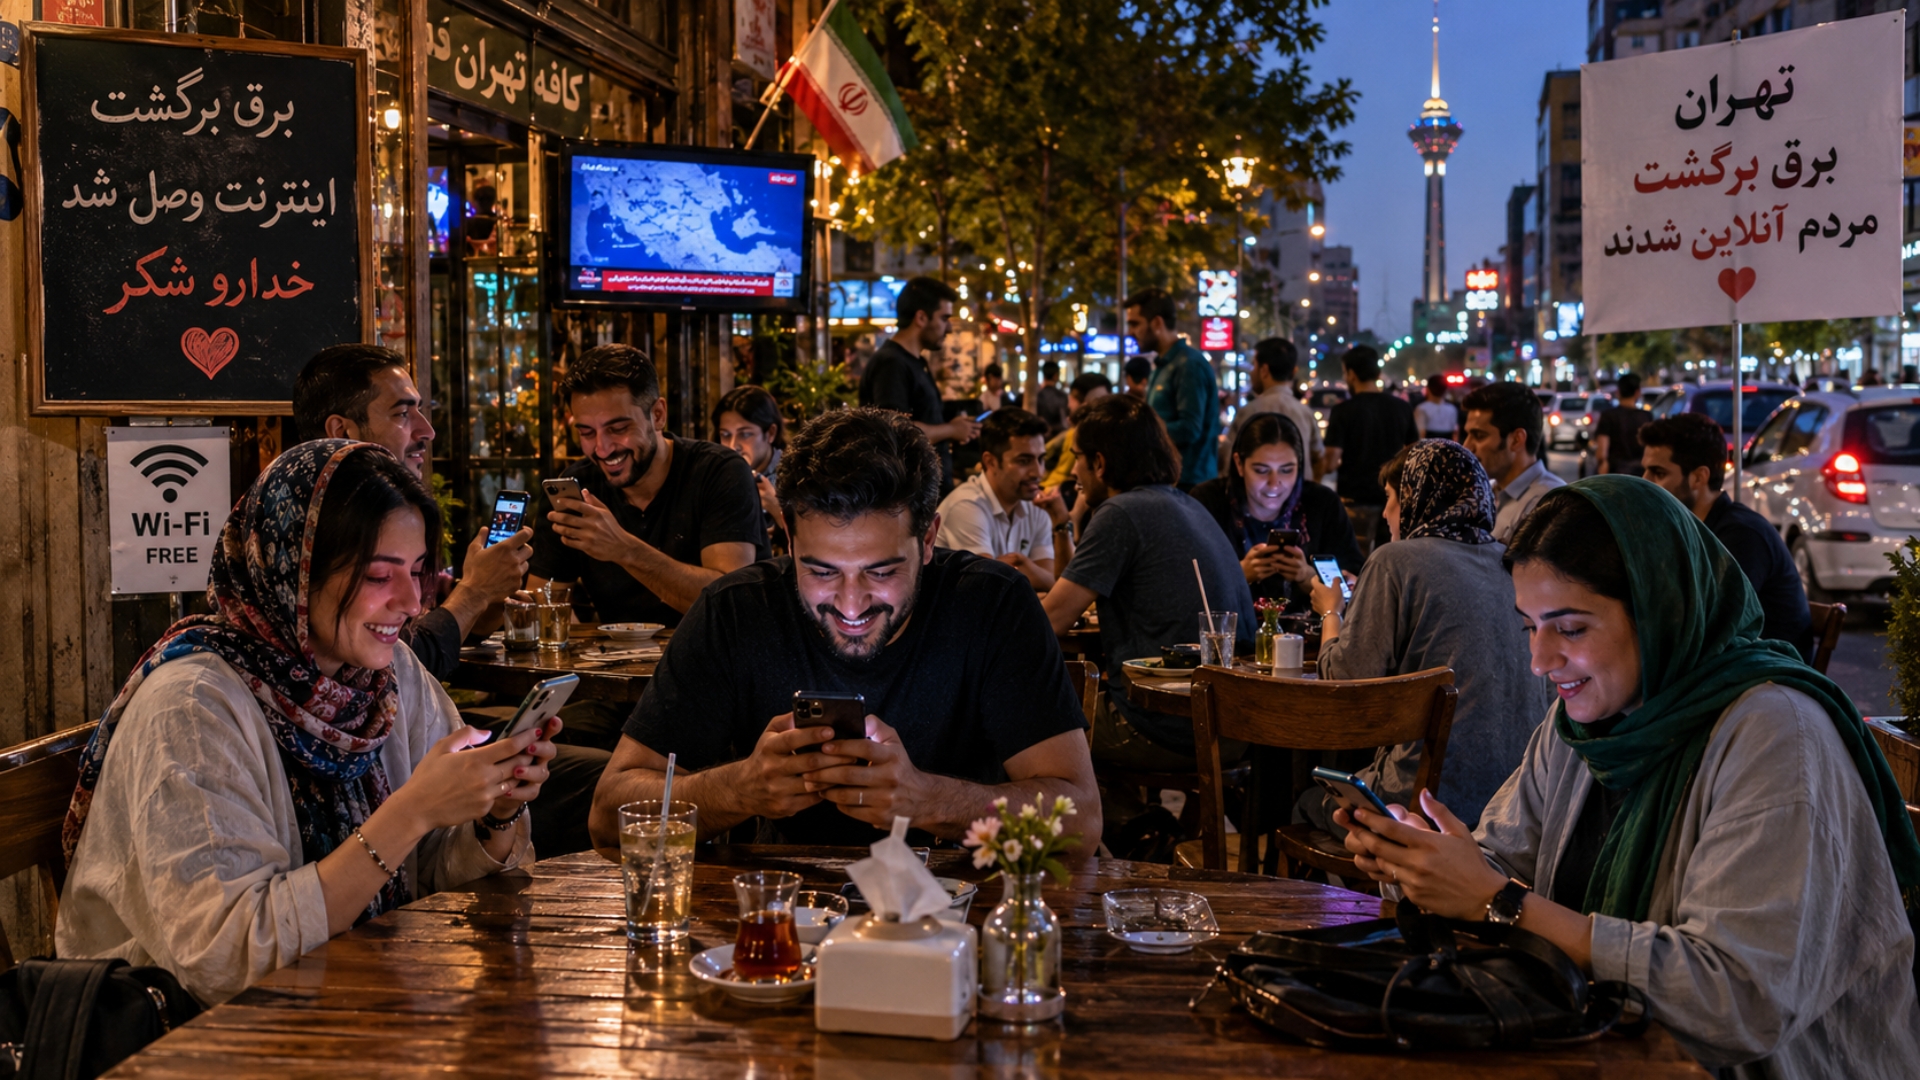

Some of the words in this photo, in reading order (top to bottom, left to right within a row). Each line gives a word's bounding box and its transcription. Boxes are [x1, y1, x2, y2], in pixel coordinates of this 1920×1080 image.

[454, 37, 527, 104] تهران
[533, 61, 584, 112] کافه
[90, 67, 221, 136] برگشت
[233, 83, 295, 138] برق
[1674, 63, 1796, 131] تهران
[62, 168, 117, 209] شد
[1633, 140, 1760, 197] برگشت
[1771, 138, 1838, 190] برق
[129, 170, 204, 225] وصل
[215, 176, 336, 228] اینترنت
[1603, 218, 1682, 258] شدند
[1691, 202, 1789, 261] آنلاین
[1798, 212, 1879, 254] مردم
[103, 245, 195, 315] شکر
[204, 257, 315, 308] خدارو
[131, 511, 210, 537] Wi-Fi
[146, 546, 199, 565] FREE
